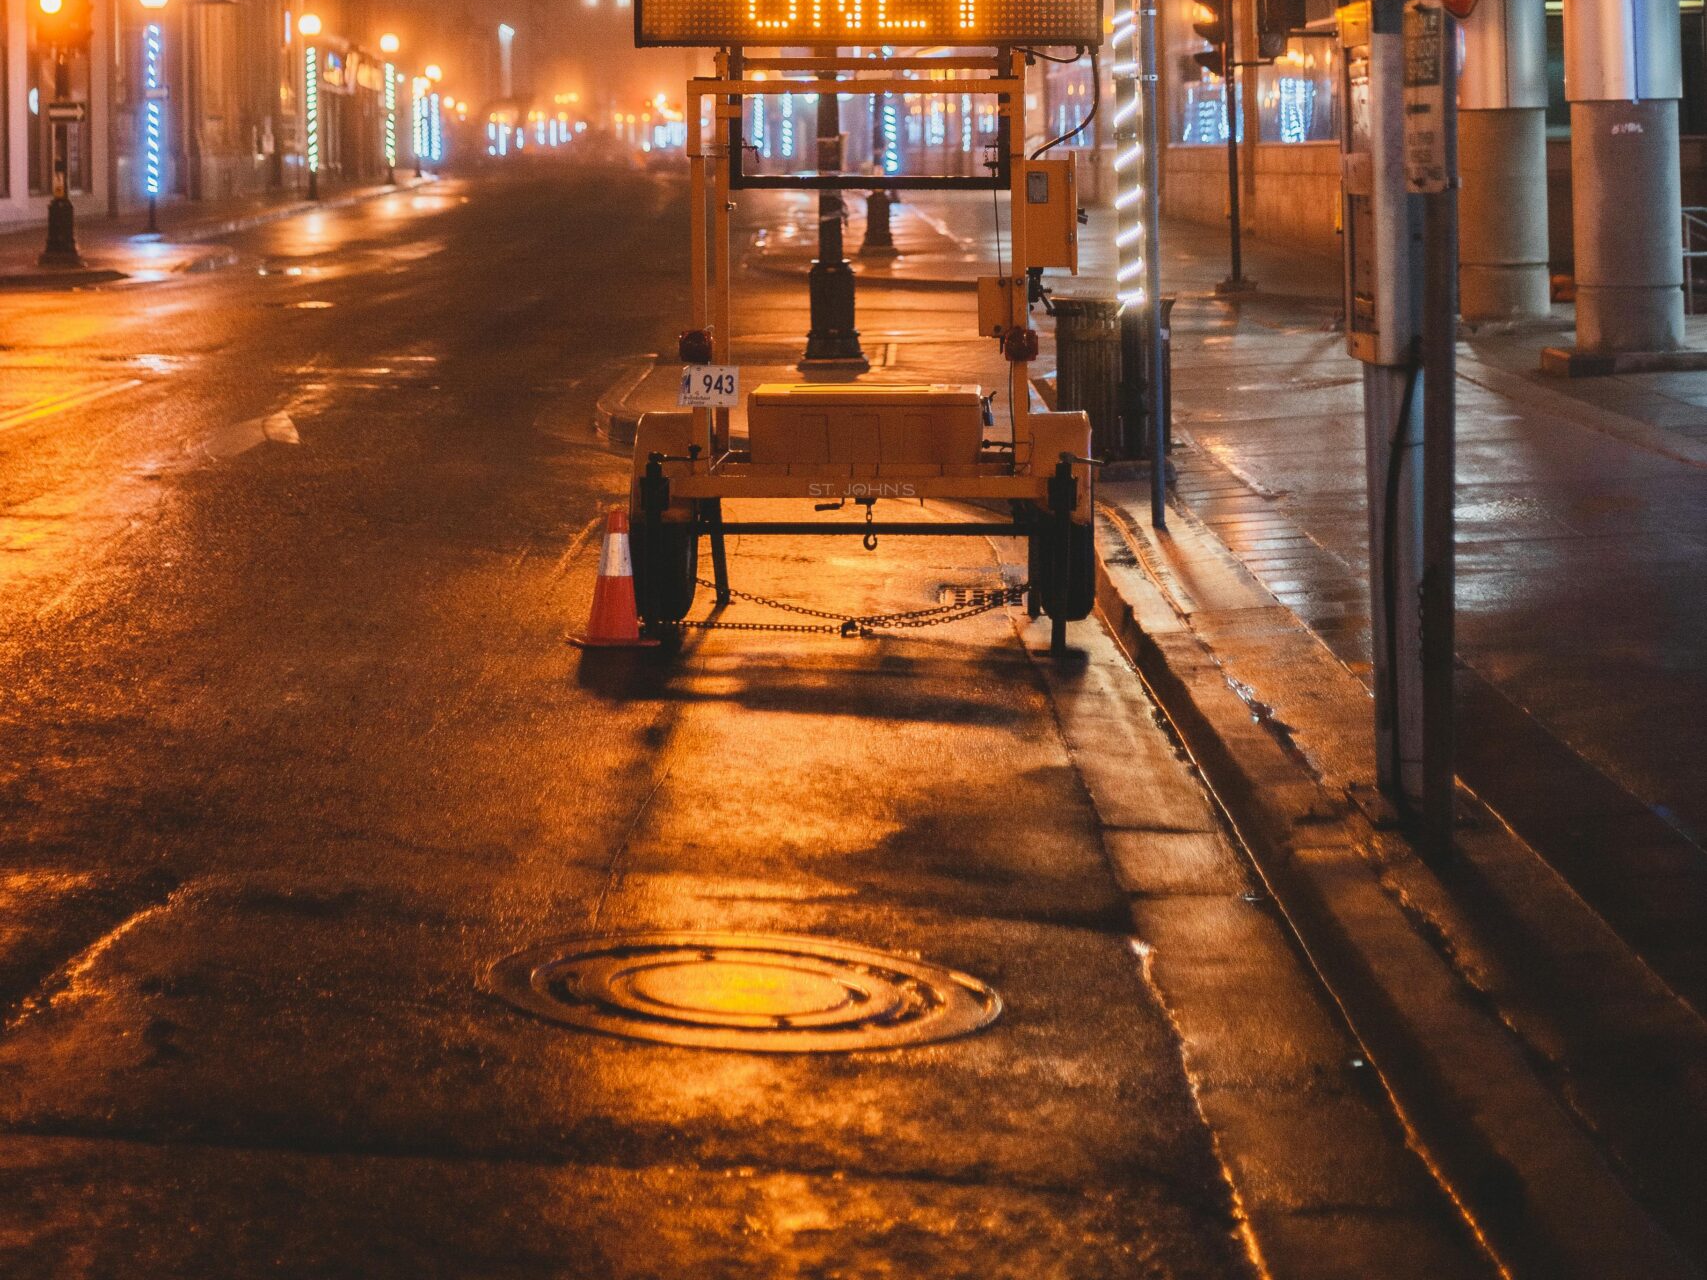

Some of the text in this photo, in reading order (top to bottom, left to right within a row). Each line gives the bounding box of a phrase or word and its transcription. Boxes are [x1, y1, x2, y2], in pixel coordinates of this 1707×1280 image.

[703, 374, 734, 395] 943
[808, 482, 916, 496] ST. JOHN'S
